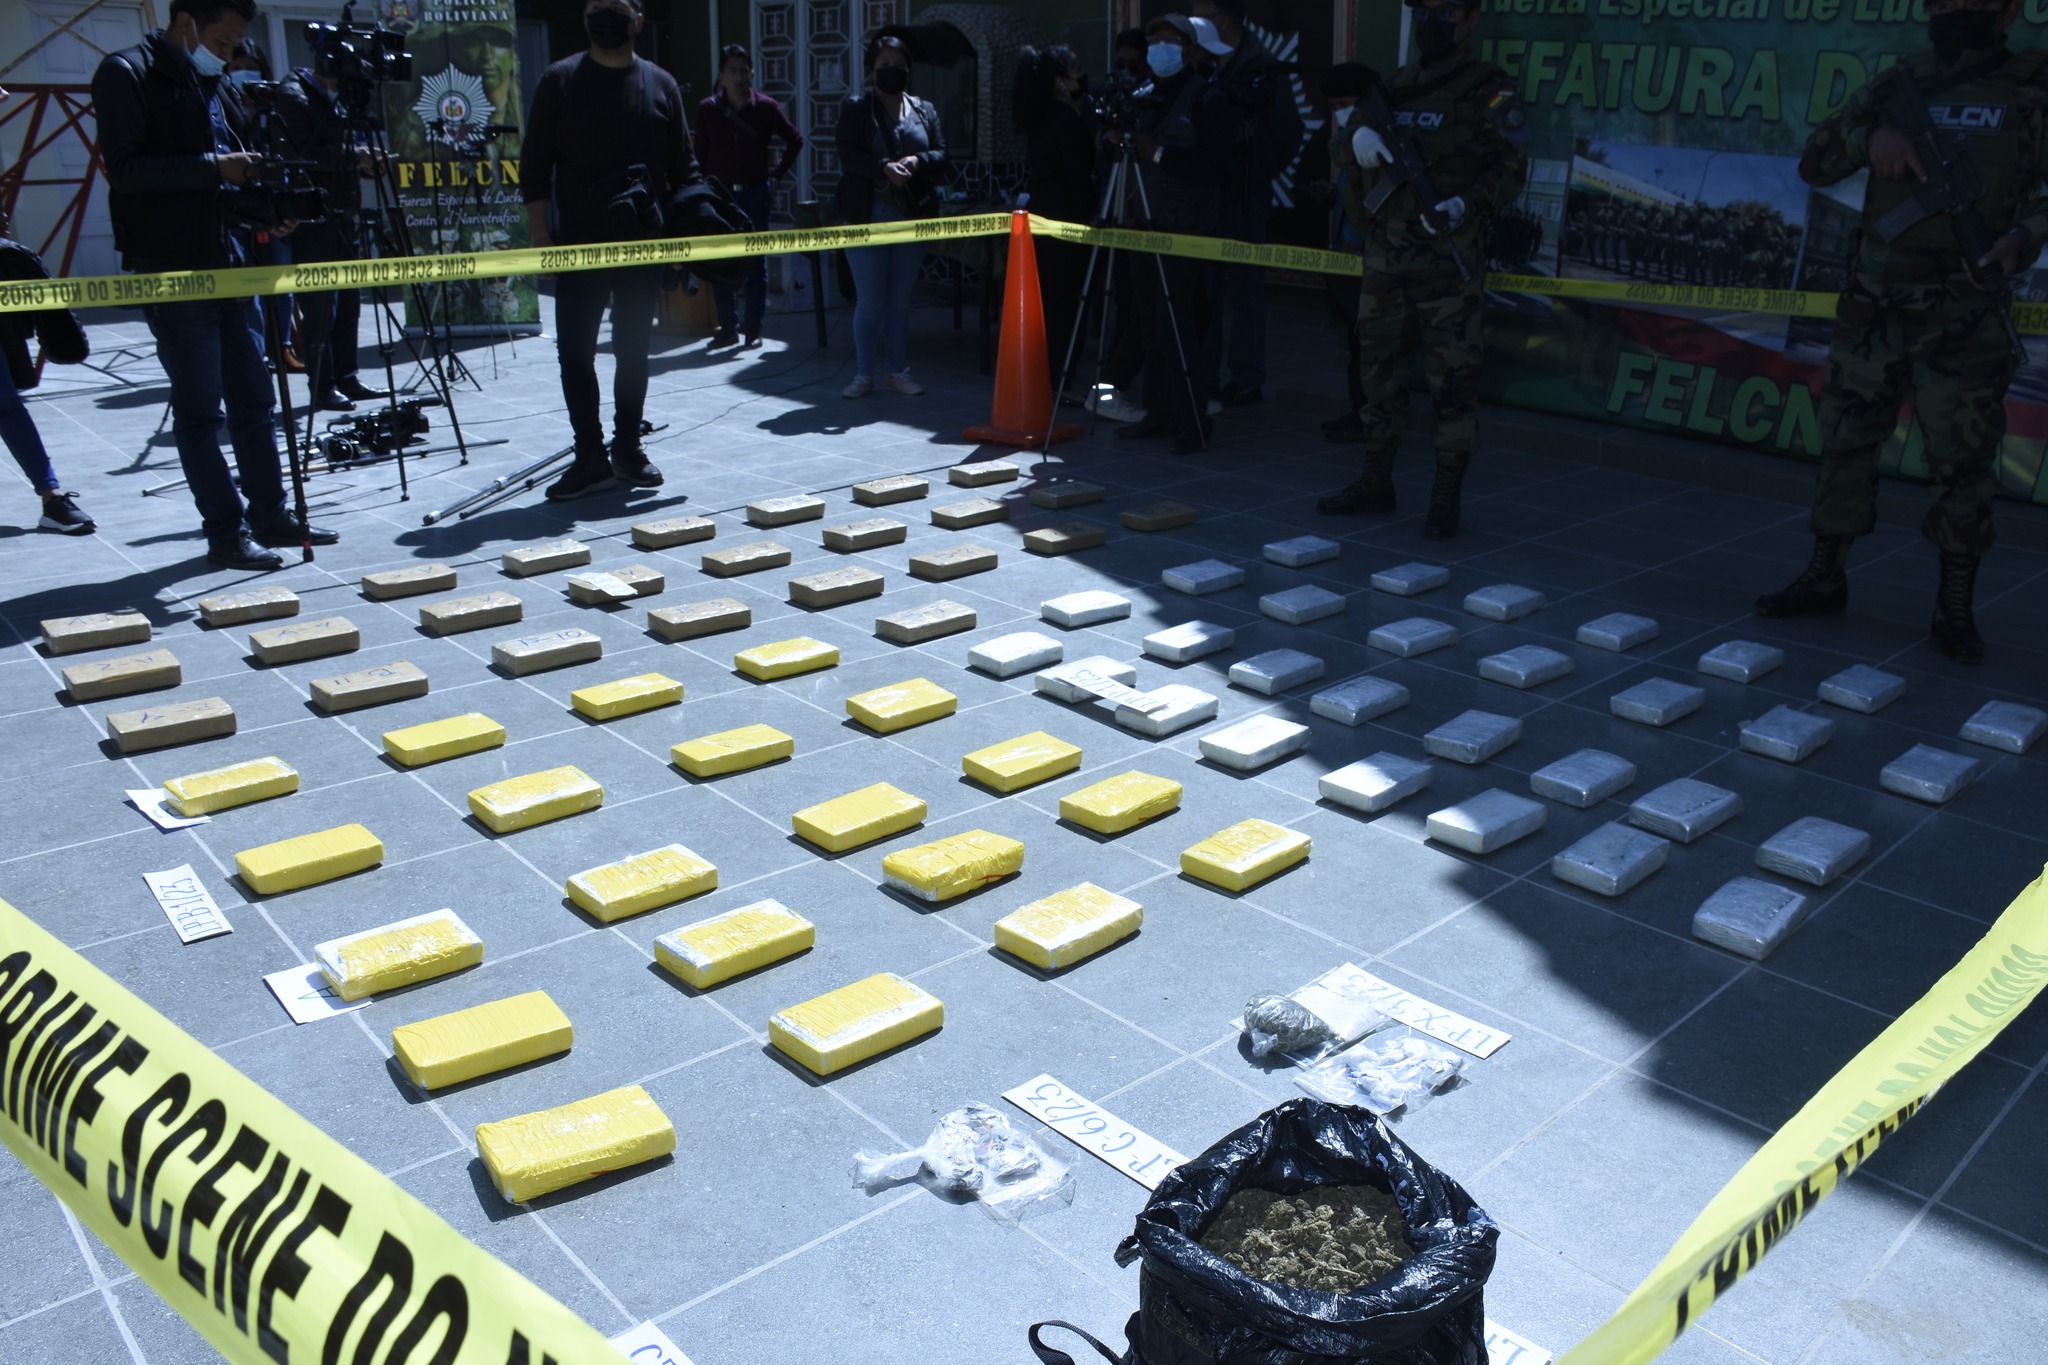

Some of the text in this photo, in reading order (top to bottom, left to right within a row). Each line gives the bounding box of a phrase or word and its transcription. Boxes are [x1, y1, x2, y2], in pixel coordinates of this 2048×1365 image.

[424, 10, 509, 22] BOLIVIANA
[1927, 106, 2003, 128] ELCN
[397, 159, 521, 188] FELCN
[107, 1072, 353, 1364] SCENE
